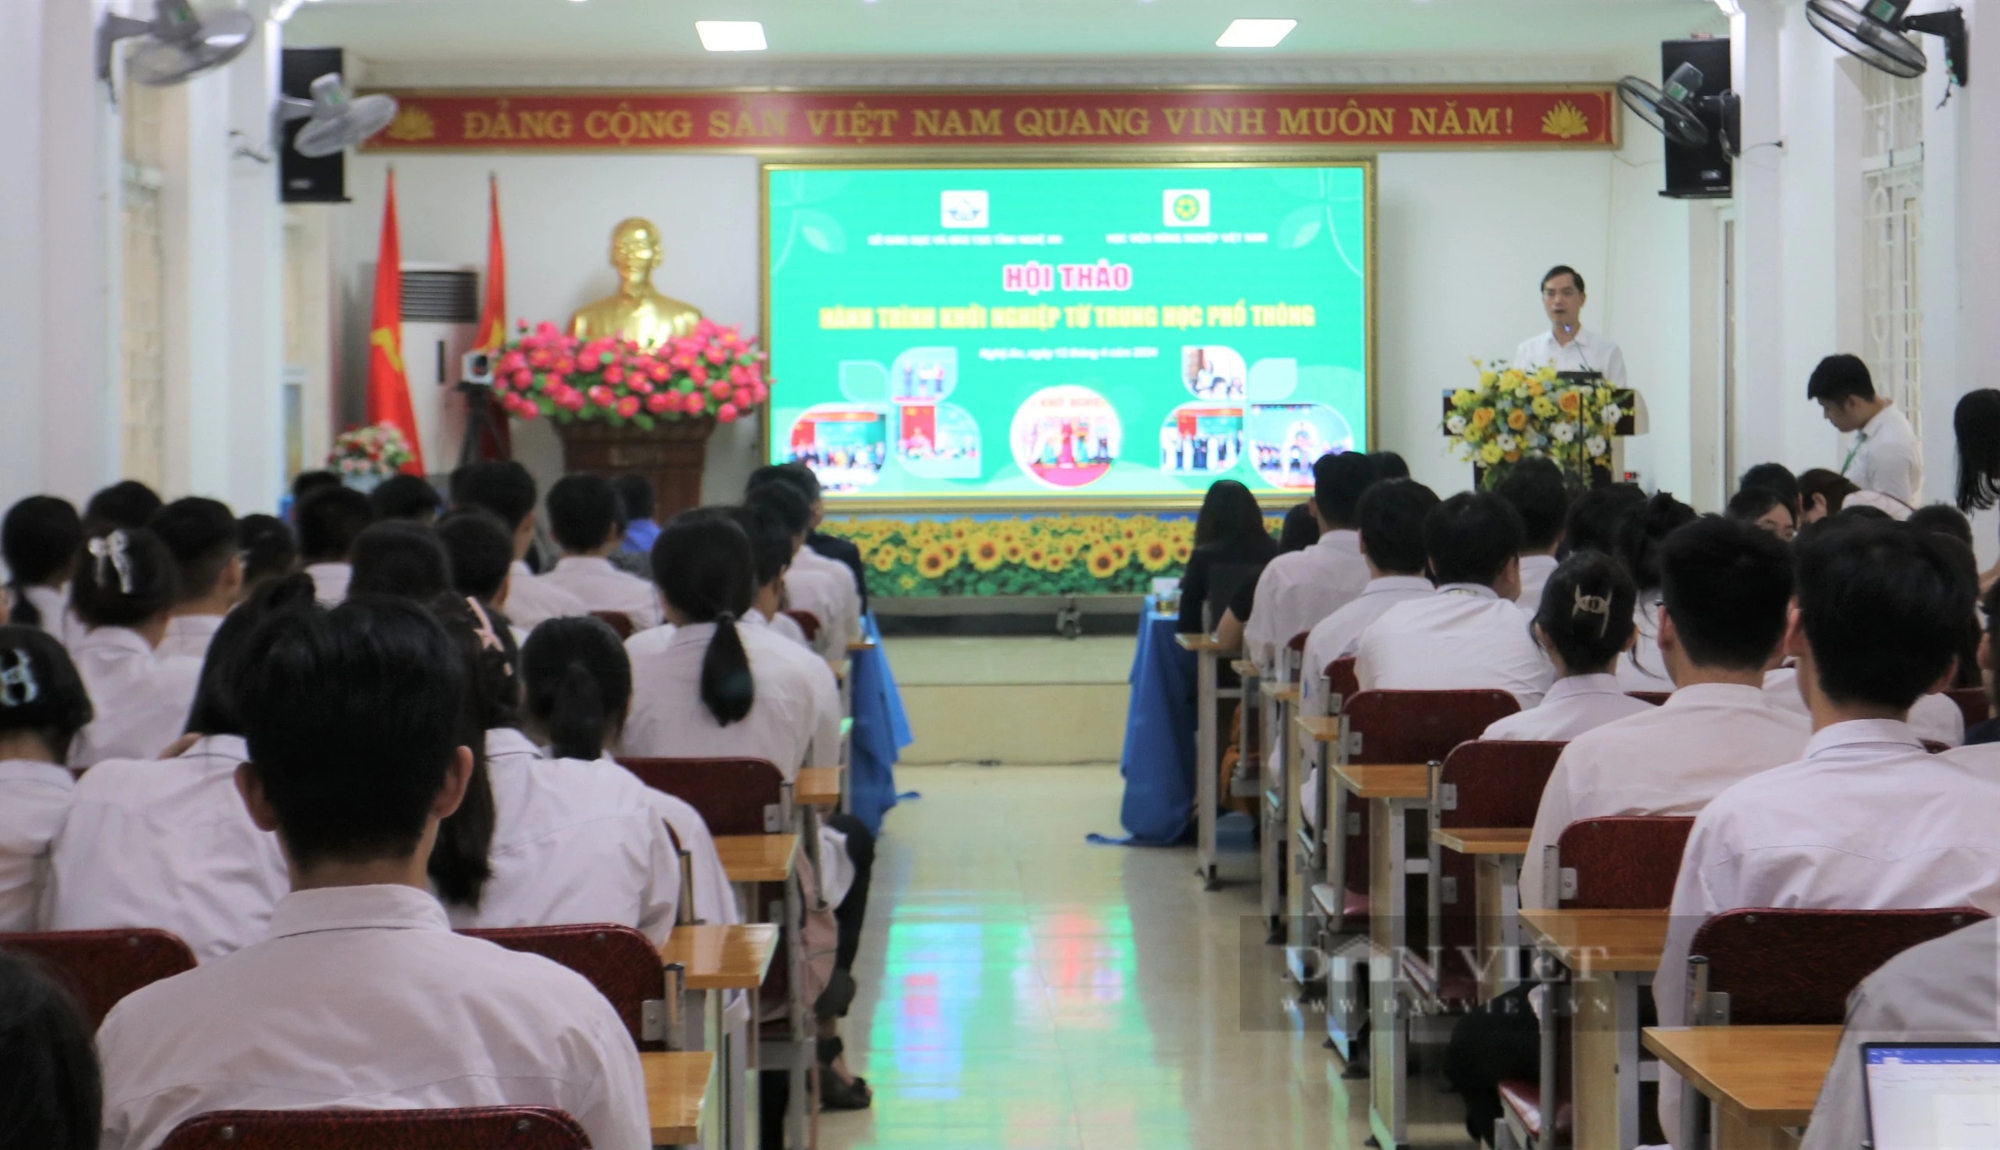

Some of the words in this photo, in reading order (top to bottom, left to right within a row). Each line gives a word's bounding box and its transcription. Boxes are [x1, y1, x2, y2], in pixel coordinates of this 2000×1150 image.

[463, 99, 572, 139] ĐẢNG
[584, 101, 692, 146] CỘNG
[708, 95, 789, 138] SẢN
[804, 100, 899, 143] VIỆT
[912, 108, 1003, 136] NAM
[1014, 107, 1149, 136] QUANG
[1162, 107, 1267, 135] VINH
[1277, 99, 1395, 135] MUÔN
[1409, 100, 1513, 135] NĂM!
[1004, 261, 1053, 295] HỘI
[1058, 259, 1131, 291] THẢO
[990, 302, 1061, 331] NGHIỆP
[1095, 306, 1158, 328] TRUNG
[1162, 306, 1203, 331] HỌC
[1250, 302, 1315, 327] THÔNG
